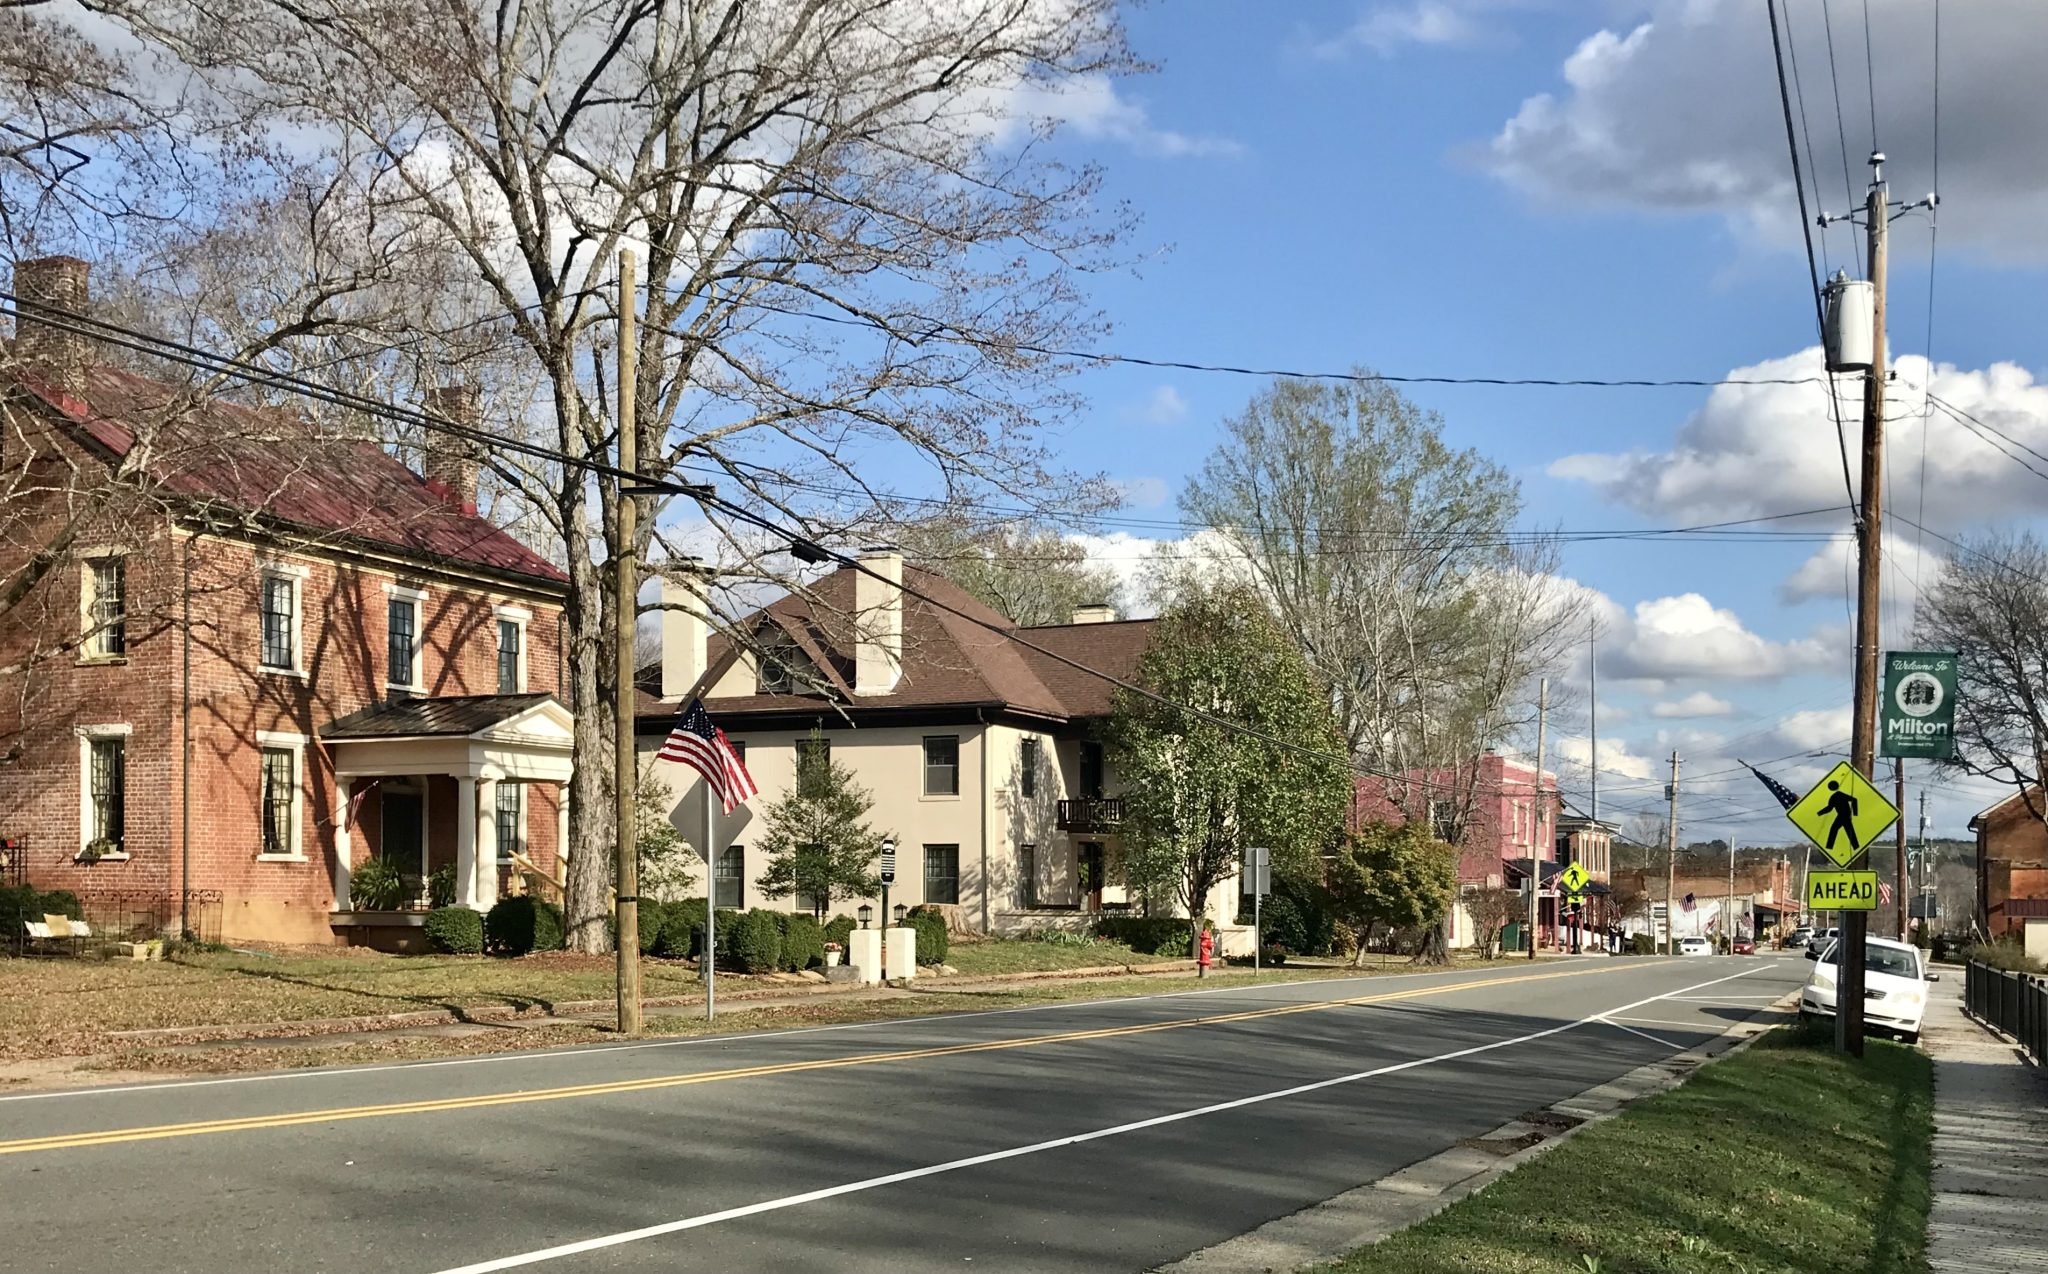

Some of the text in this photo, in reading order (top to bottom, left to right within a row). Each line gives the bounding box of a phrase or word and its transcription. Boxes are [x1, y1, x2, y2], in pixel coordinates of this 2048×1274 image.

[1892, 660, 1950, 671] Welcome To
[1888, 718, 1948, 735] Milton
[1813, 882, 1873, 899] AHEAD
